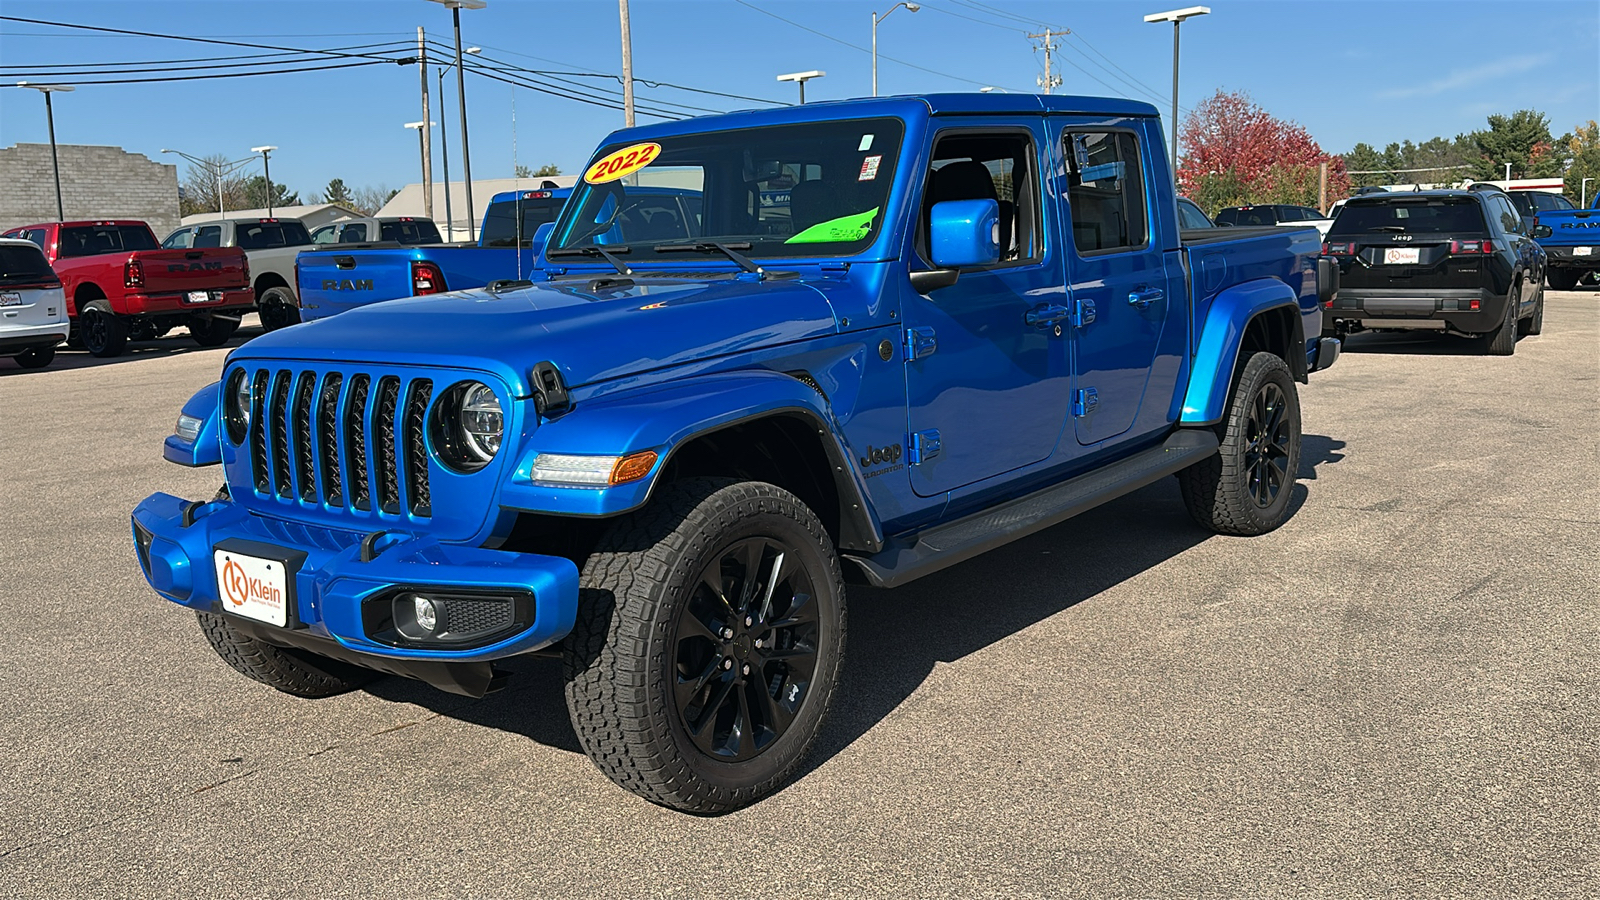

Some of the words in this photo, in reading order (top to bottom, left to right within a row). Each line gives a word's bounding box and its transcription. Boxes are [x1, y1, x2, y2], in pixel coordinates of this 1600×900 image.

[591, 146, 654, 180] 2022
[1392, 234, 1413, 242] Jeep
[168, 262, 222, 272] RAM
[322, 279, 374, 291] RAM
[861, 443, 902, 467] Jeep
[249, 577, 280, 604] Klein
